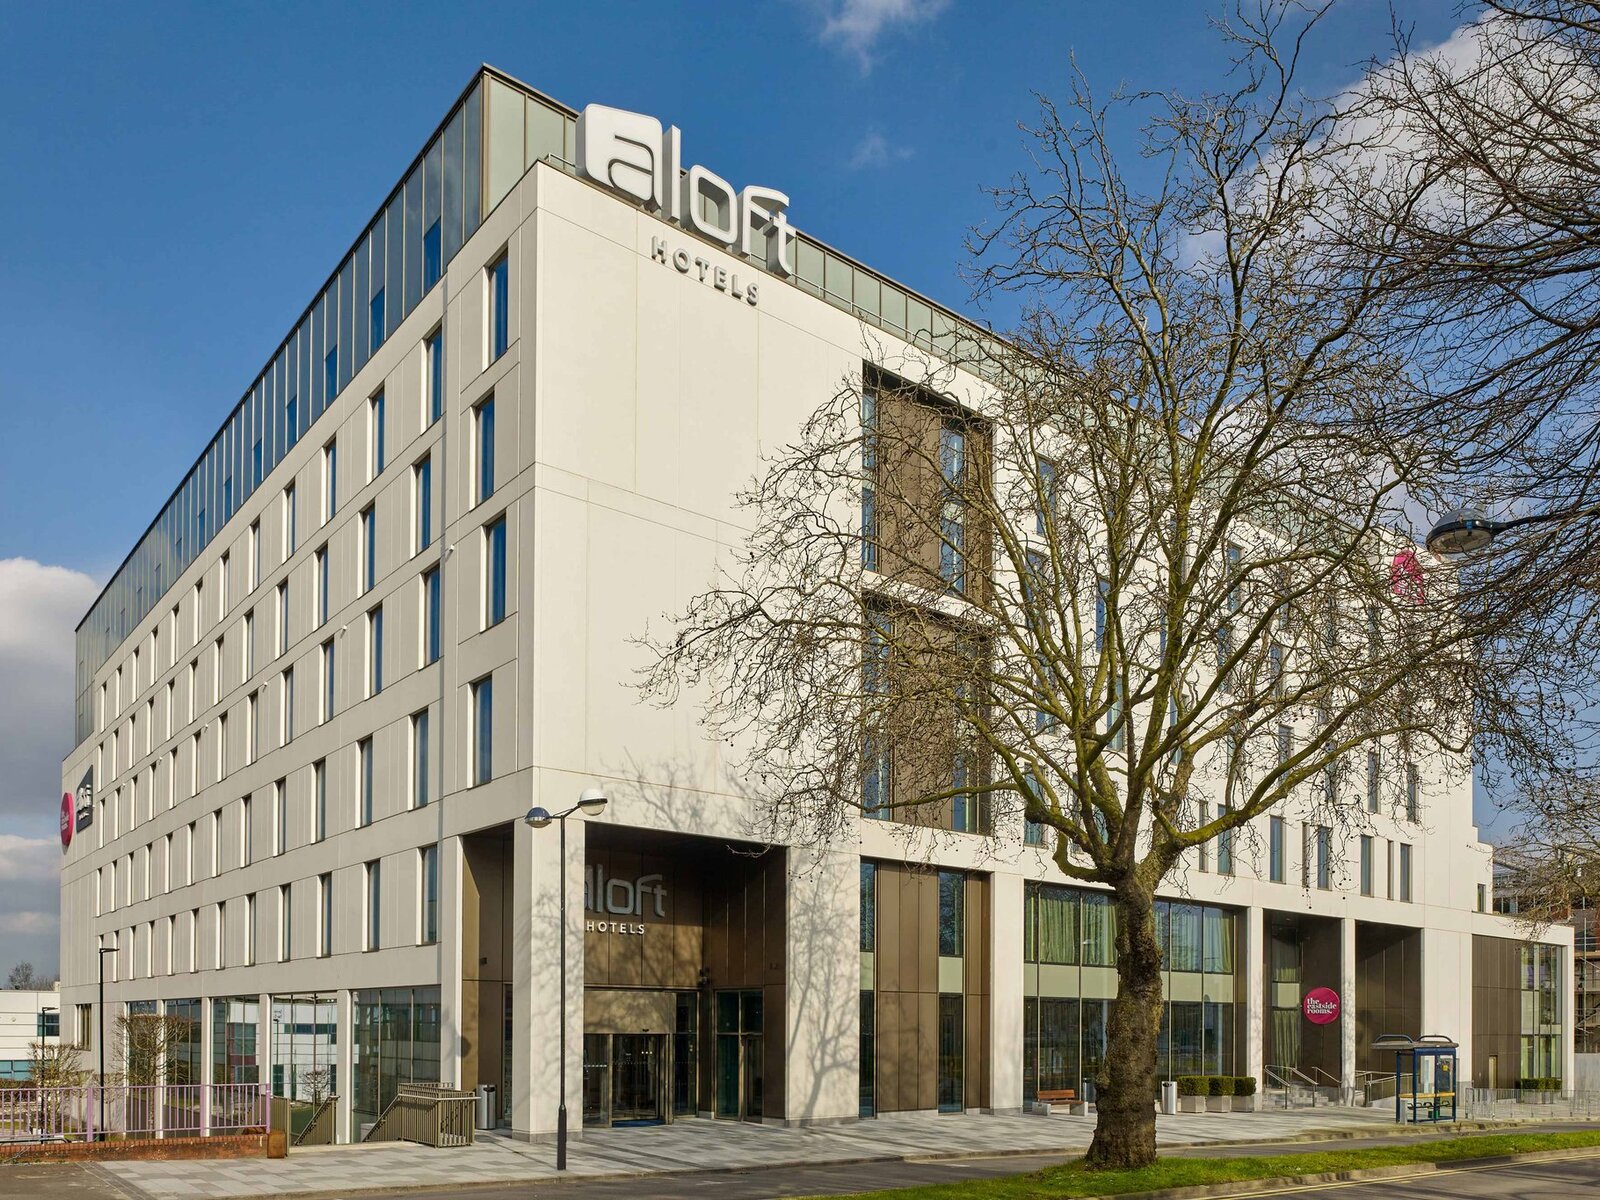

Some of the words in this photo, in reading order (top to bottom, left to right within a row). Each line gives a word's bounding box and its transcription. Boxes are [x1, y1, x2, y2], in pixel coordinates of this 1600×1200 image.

[576, 103, 796, 279] aloft
[651, 235, 759, 307] HOTELS
[584, 863, 668, 918] loft
[586, 920, 646, 936] HOTELS
[1307, 997, 1319, 1005] the
[1307, 1002, 1337, 1010] eastside
